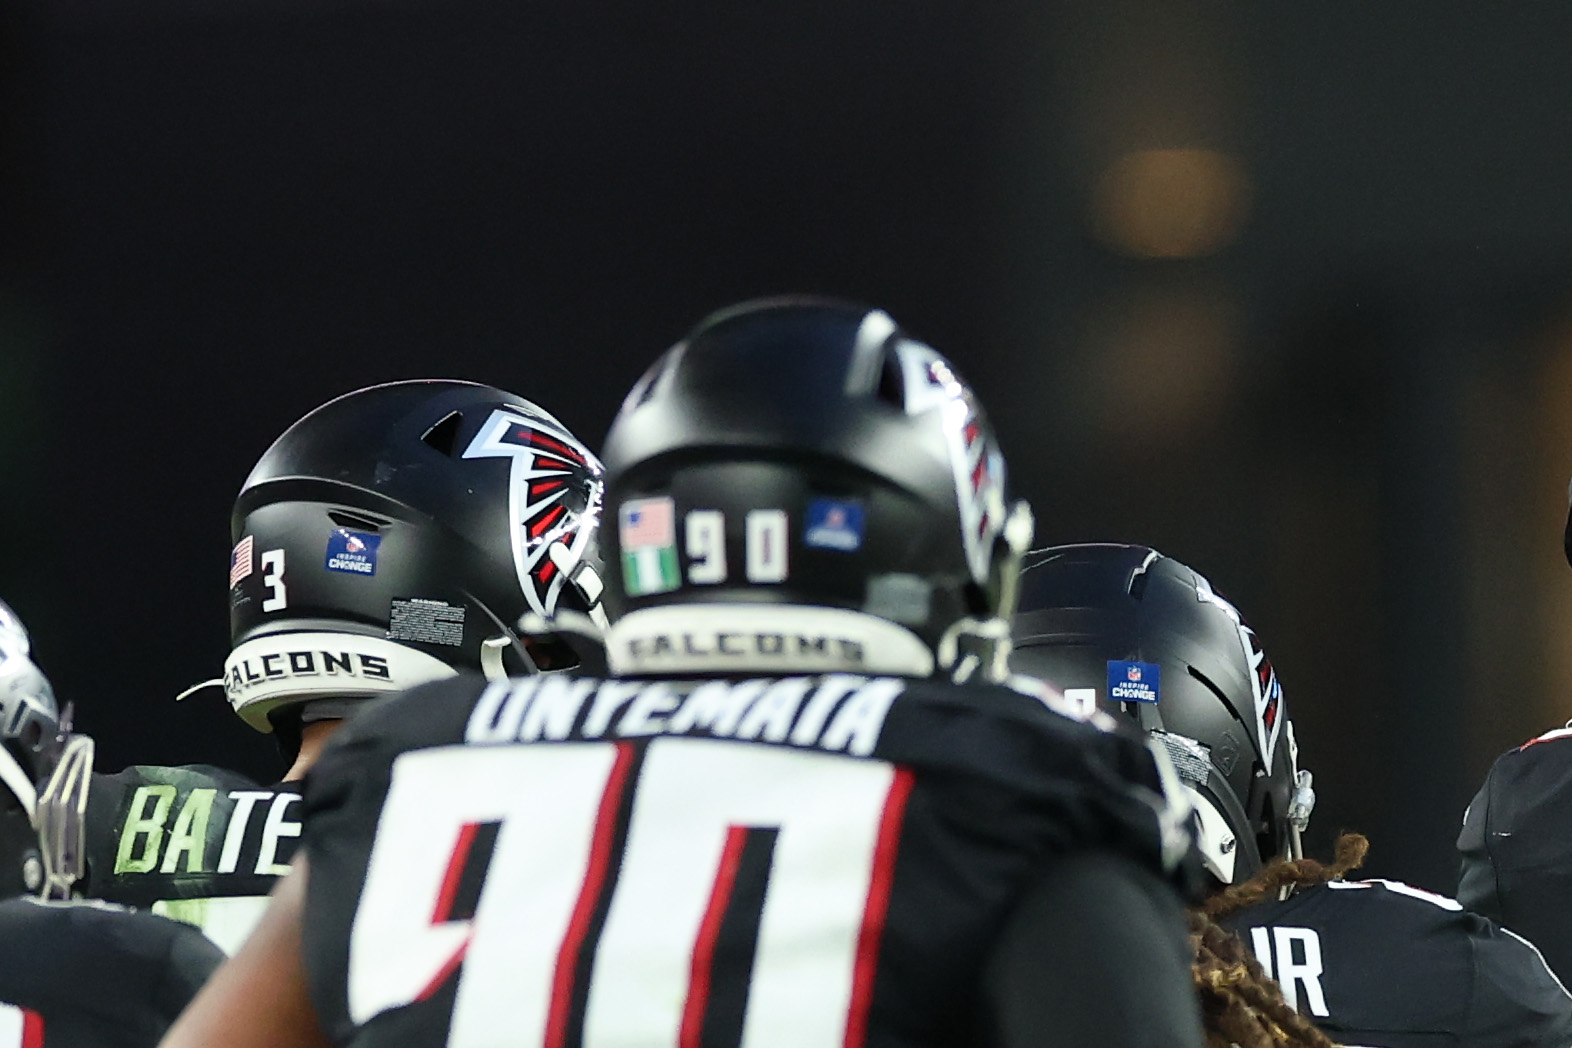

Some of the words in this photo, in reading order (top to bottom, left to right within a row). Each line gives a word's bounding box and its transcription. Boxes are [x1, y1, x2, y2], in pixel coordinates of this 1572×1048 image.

[684, 509, 789, 584] 90
[261, 548, 288, 613] 3
[328, 558, 373, 573] CHANGE
[626, 631, 864, 663] FALCONS
[224, 651, 393, 690] FALCONS
[1112, 687, 1156, 701] CHANGE
